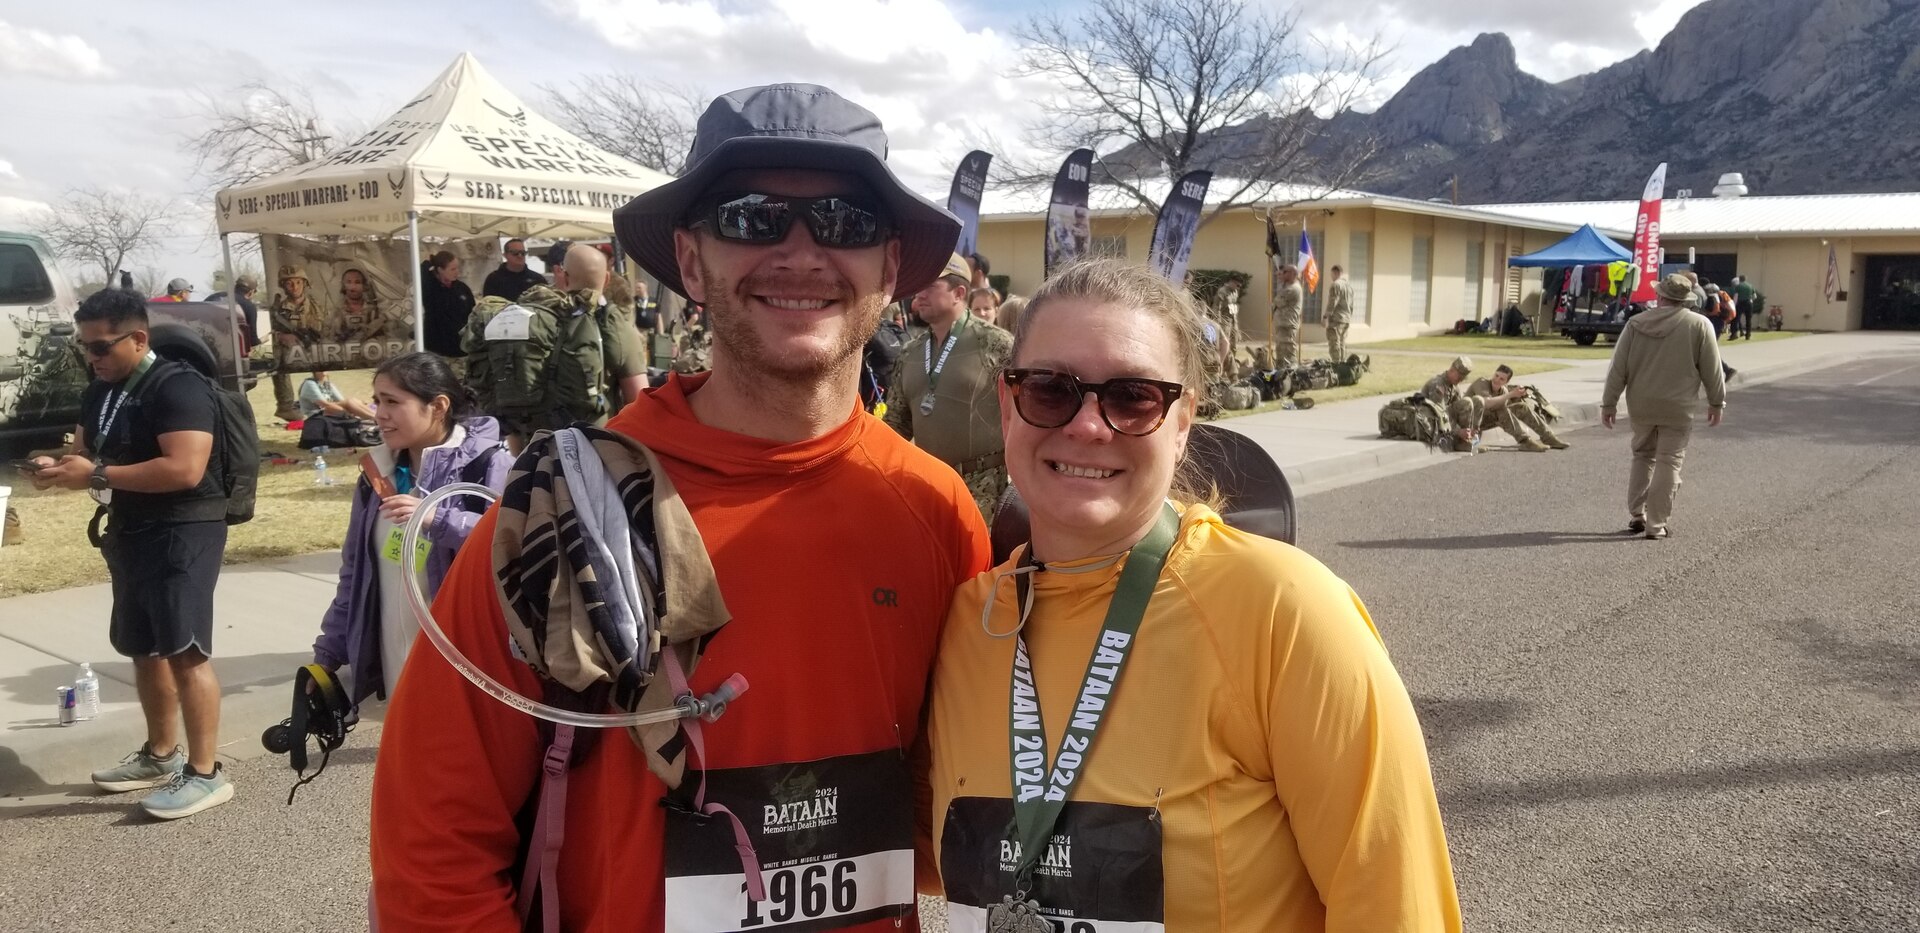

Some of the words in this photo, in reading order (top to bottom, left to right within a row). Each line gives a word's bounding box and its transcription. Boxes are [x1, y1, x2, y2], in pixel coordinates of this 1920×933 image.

[498, 127, 532, 139] AIR
[461, 136, 609, 166] SPECIAL
[479, 154, 641, 180] WARFARE
[1067, 162, 1088, 182] EOD
[237, 196, 258, 215] SERE
[265, 191, 301, 212] SPECIAL
[302, 184, 349, 206] WARFARE
[358, 180, 379, 200] EOD
[464, 181, 505, 200] SERE
[520, 185, 585, 207] SPECIAL
[587, 191, 635, 209] WARF
[1181, 180, 1205, 201] SERE
[1637, 212, 1649, 243] AND
[1646, 221, 1660, 274] FOUND
[944, 335, 958, 352] 2024
[391, 530, 426, 552] MIA
[872, 587, 899, 607] OR
[1013, 635, 1042, 730] BATAAN
[1071, 629, 1132, 731] BATAAN
[1013, 734, 1045, 804] 2024
[1043, 733, 1090, 803] 2024
[815, 787, 838, 798] 2024
[764, 796, 838, 825] BATAAN
[763, 823, 797, 835] Memorial
[797, 819, 818, 831] Death
[818, 815, 838, 827] March
[763, 861, 780, 870] WHITE
[800, 855, 821, 864] MISSILE
[822, 852, 839, 861] RANGE
[1000, 839, 1072, 868] BAAN
[1051, 867, 1072, 878] March
[741, 860, 857, 928] 1966
[1058, 908, 1075, 917] RANGE
